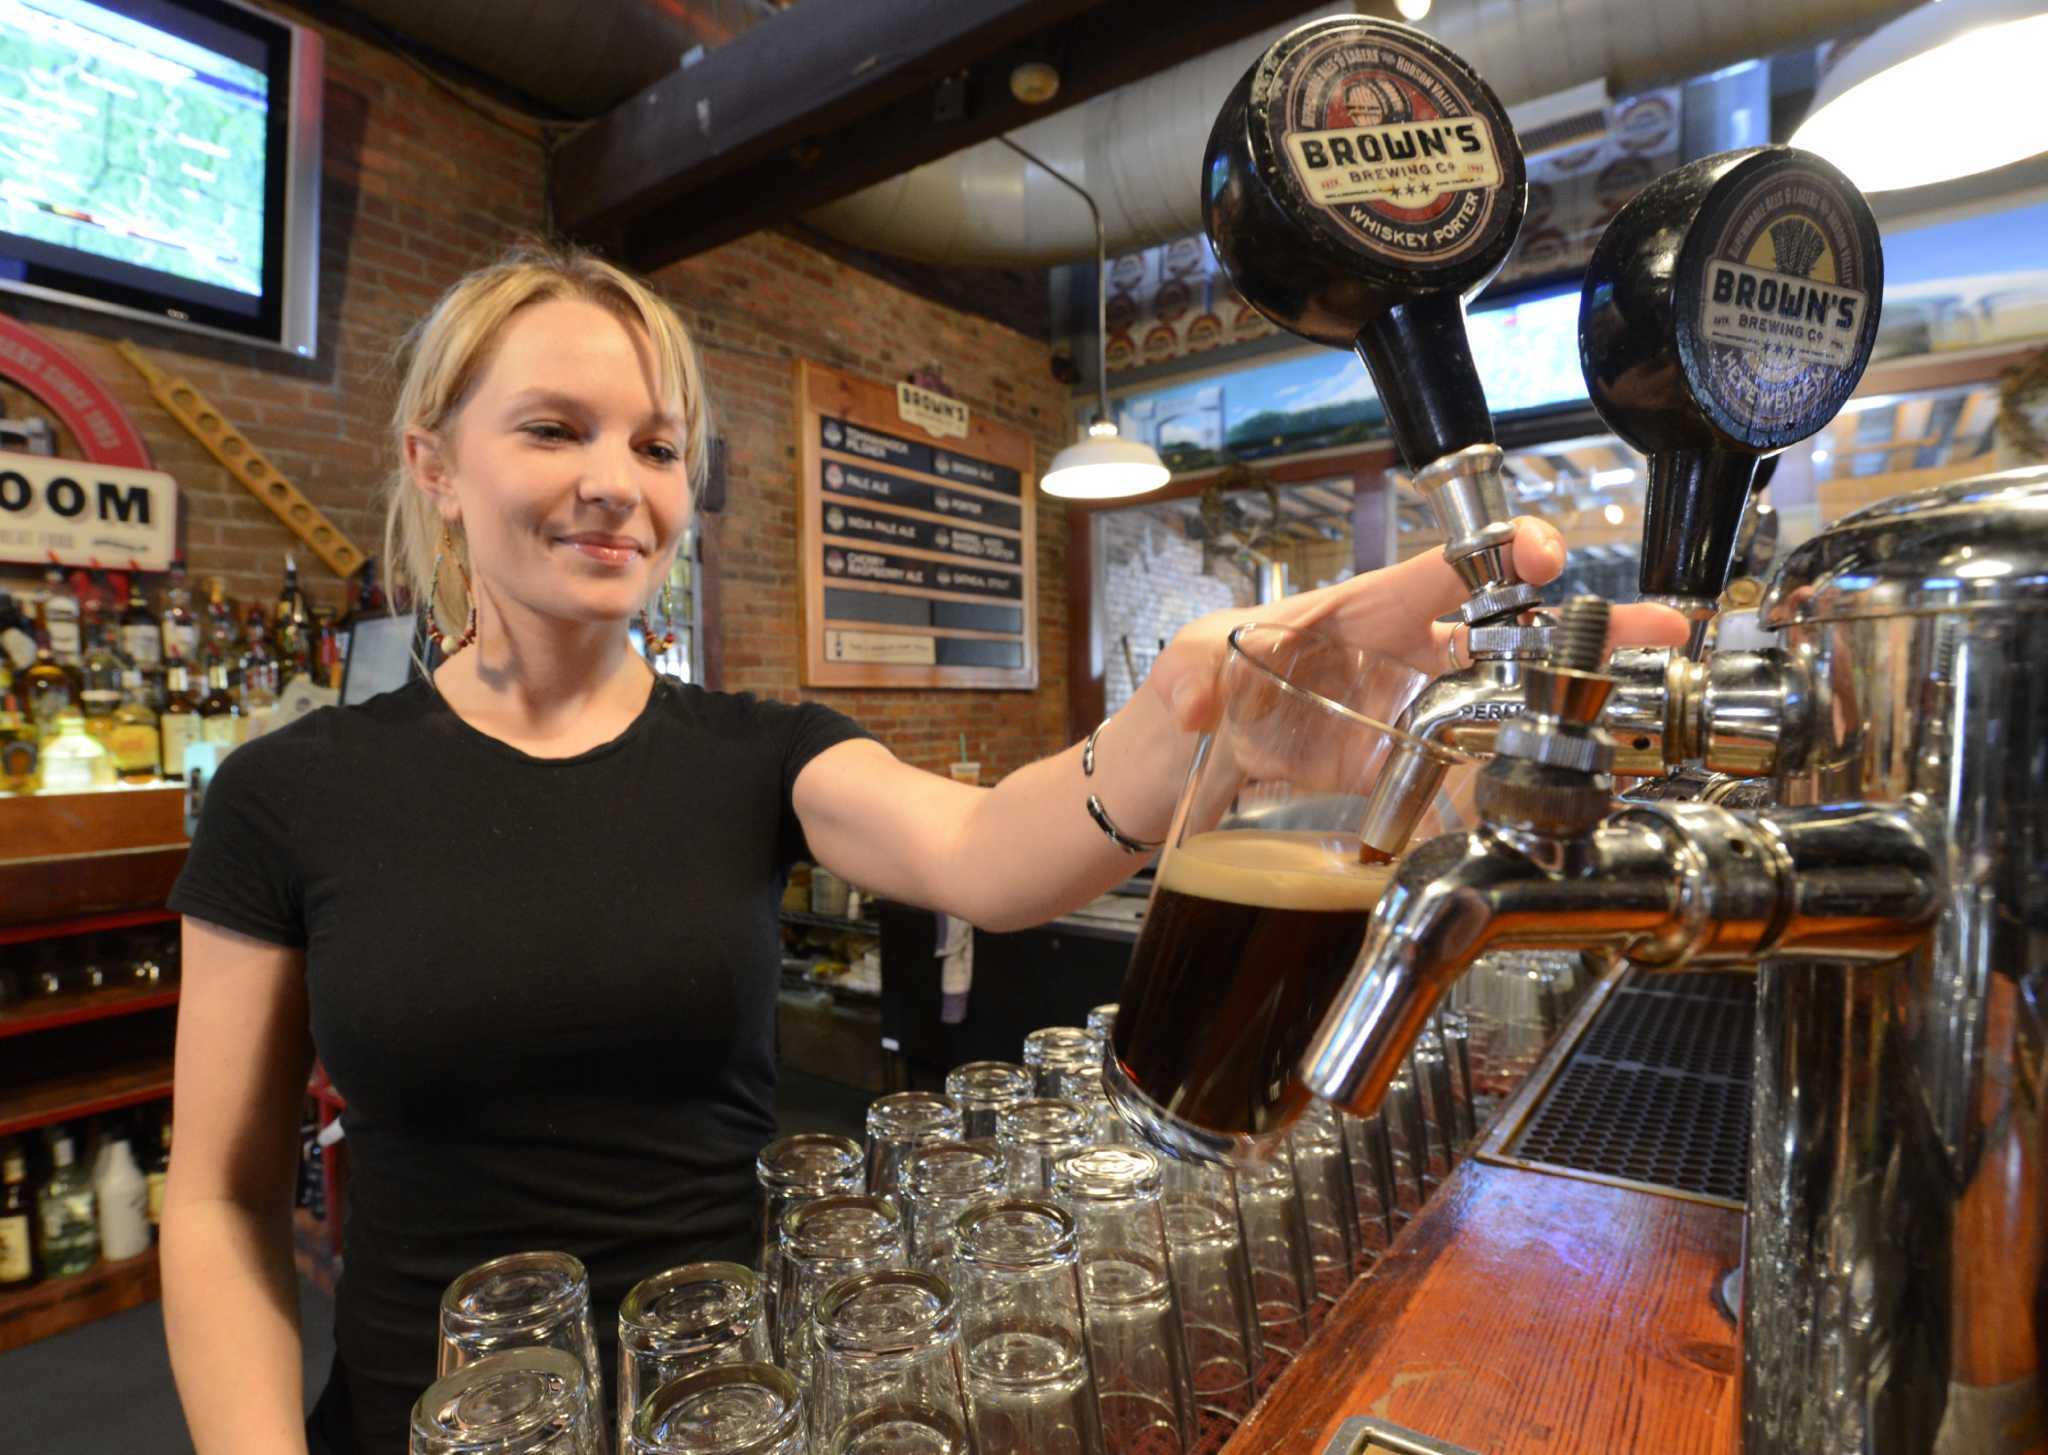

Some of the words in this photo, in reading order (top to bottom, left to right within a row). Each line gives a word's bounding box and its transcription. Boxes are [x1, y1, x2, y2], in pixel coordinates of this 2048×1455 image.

[1396, 56, 1435, 89] HUDSON
[1430, 80, 1462, 115] VALLEY
[1300, 123, 1482, 169] BROWN'S
[1349, 163, 1432, 184] BREWING
[1349, 205, 1430, 248] WHISKEY
[1433, 191, 1479, 245] PORTER
[1713, 267, 1858, 329] BROWN'S
[1738, 313, 1805, 339] BREWING
[902, 387, 965, 422] BROWN'S
